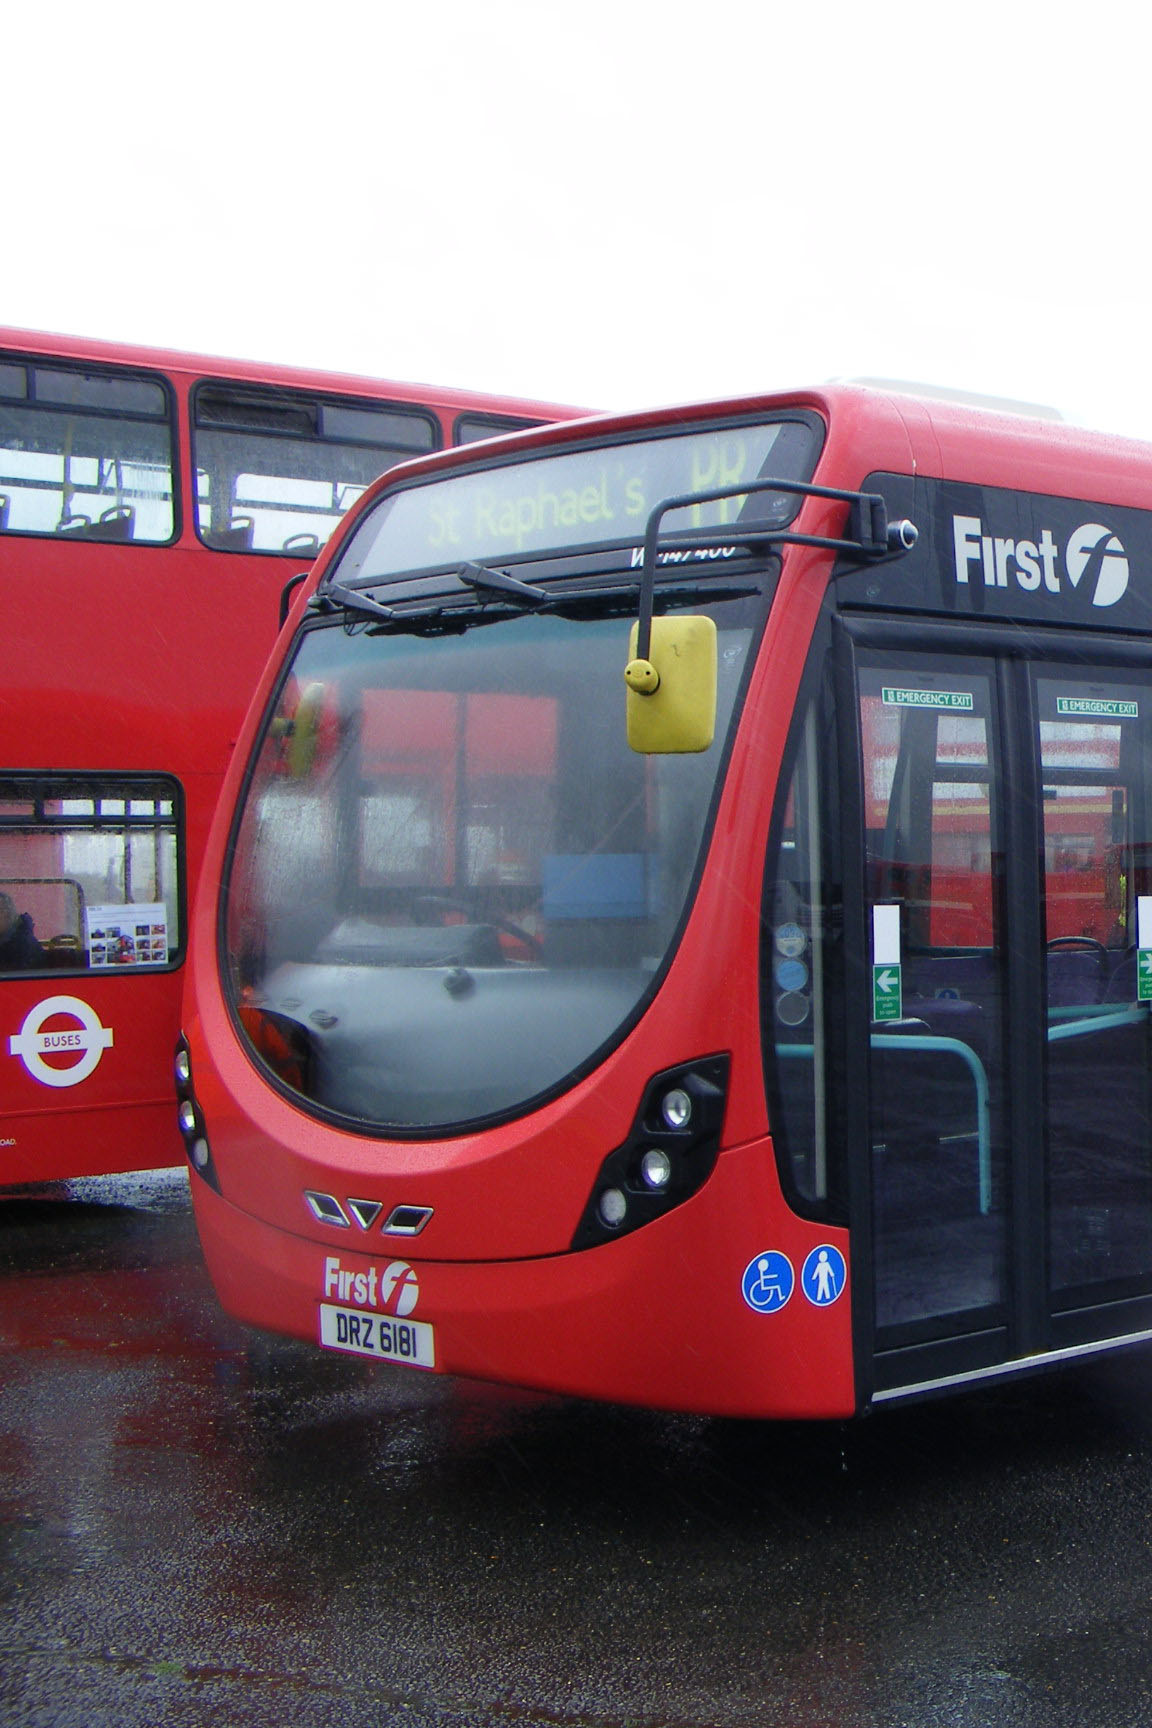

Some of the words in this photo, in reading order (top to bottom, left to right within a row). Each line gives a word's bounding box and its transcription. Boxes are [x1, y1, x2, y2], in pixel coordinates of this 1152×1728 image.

[428, 502, 461, 545] St
[475, 464, 647, 549] Raphael's
[953, 515, 1060, 594] First
[896, 692, 950, 706] EMERGENCY
[951, 695, 971, 707] EXIT
[1069, 701, 1117, 713] EMERGENCY
[1119, 703, 1136, 714] EXIT
[43, 1034, 82, 1048] BUSES
[325, 1256, 378, 1307] First
[336, 1312, 375, 1350] DRZ
[379, 1321, 417, 1358] 6181
